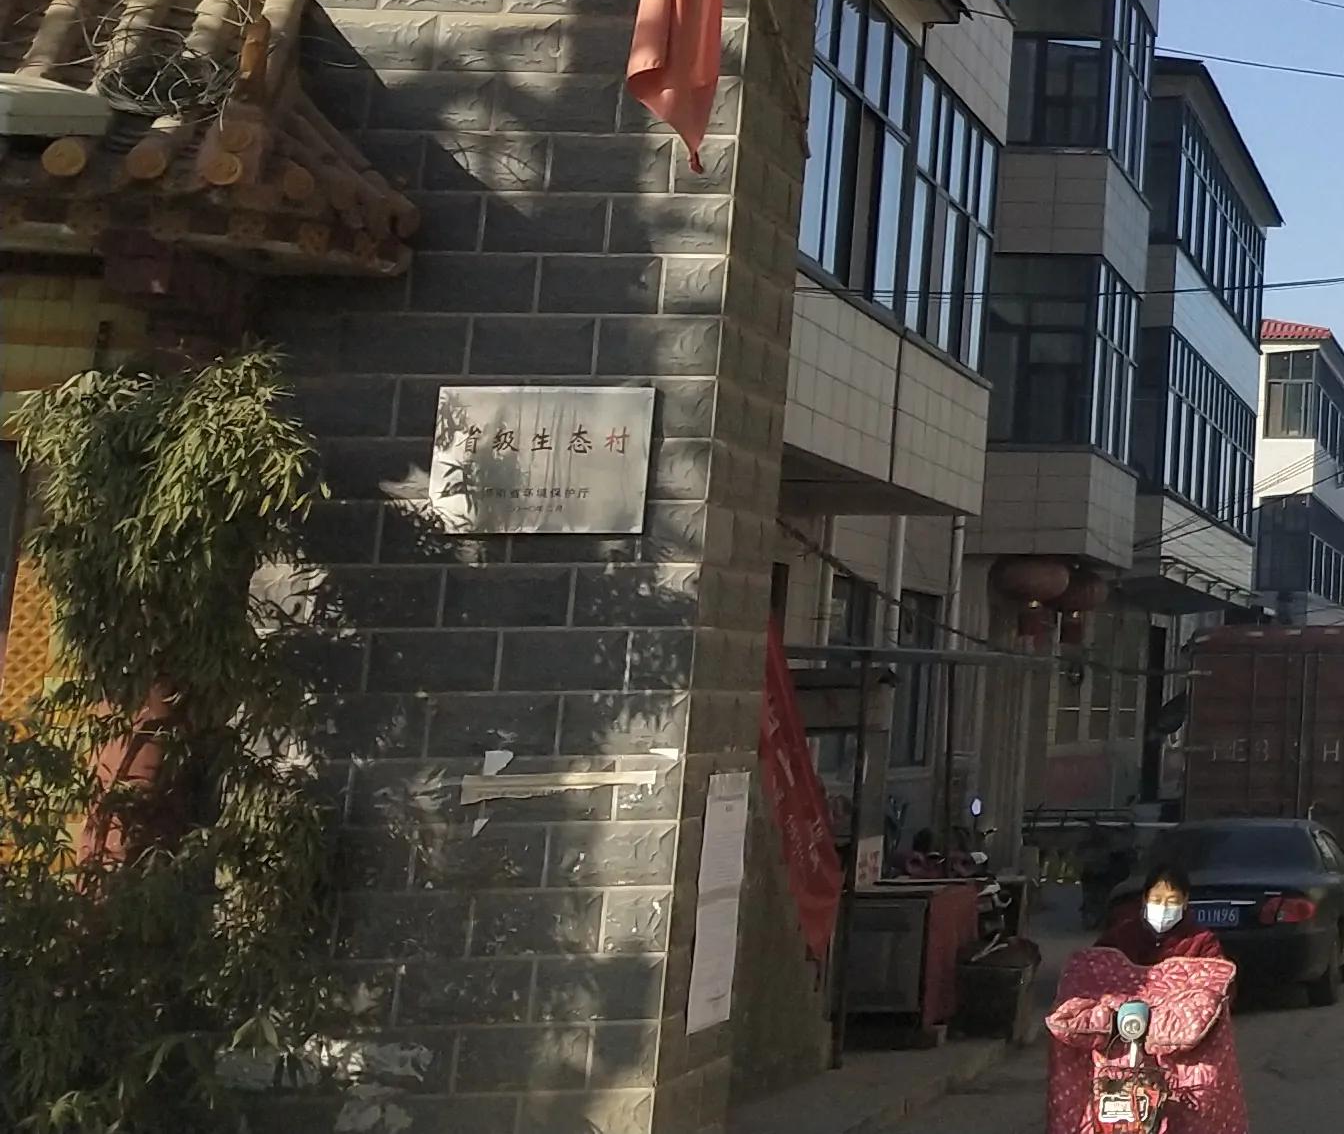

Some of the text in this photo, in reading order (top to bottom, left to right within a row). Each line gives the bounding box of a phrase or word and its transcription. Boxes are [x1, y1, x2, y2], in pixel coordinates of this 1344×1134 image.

[455, 423, 630, 455] 省级生态村
